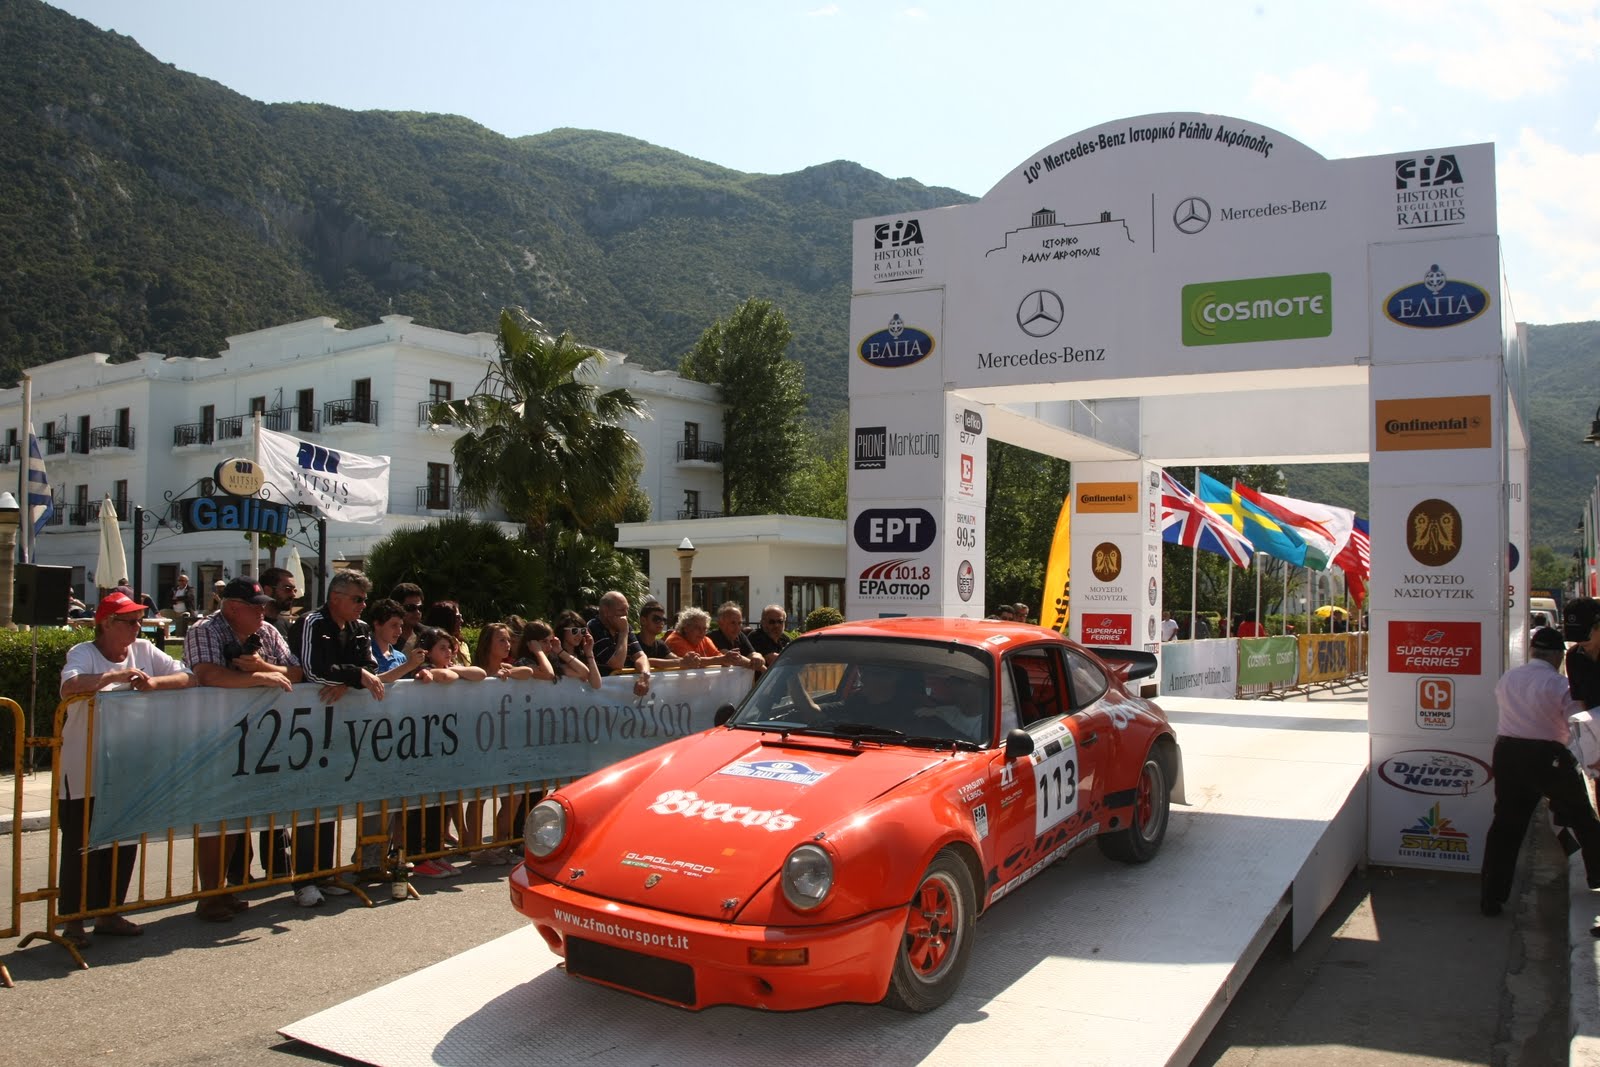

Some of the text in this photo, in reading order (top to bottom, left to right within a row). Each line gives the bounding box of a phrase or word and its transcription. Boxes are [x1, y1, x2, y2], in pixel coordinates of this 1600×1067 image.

[1043, 133, 1126, 172] Mercedes-Benz
[1129, 121, 1175, 143] Ιστορικό
[1178, 121, 1213, 140] Ράλλυ
[1214, 125, 1274, 158] Ακρόπολις
[1397, 187, 1465, 204] HISTORIC
[1220, 199, 1328, 222] Mercedes-Benz
[1396, 199, 1465, 212] REGULARITY
[1397, 207, 1465, 226] RALLIES
[1042, 236, 1079, 249] ΙΣΤΟΡΙΚΟ
[874, 246, 925, 262] HISTORIC
[1052, 246, 1101, 260] ΑΚΡΟΠΟΛΙΣ
[874, 258, 924, 271] RALLY
[873, 268, 925, 280] CHAMPIONSHIP
[1203, 295, 1324, 323] COSMOTE
[1398, 294, 1475, 319] ΕΛΠΑ
[868, 339, 924, 360] ΕΛΠΑ
[977, 346, 1106, 370] Mercedes-Benz
[964, 412, 981, 431] lefko
[1385, 416, 1468, 435] Continental
[857, 431, 940, 459] PHONE Marketing
[229, 475, 259, 486] MITSIS
[290, 470, 349, 496] MITSIS
[1081, 494, 1126, 504] Continental
[192, 498, 289, 535] Galini
[894, 566, 931, 580] 101.8
[1404, 574, 1465, 586] ΜΟΥΣΕΙΟ
[1090, 586, 1123, 594] ΜΟΥΣΕΙΟ
[1394, 588, 1475, 600] ΝΑΣΙΟΥΤΖΙΚ
[1086, 627, 1127, 635] SUPERFAST
[1396, 645, 1473, 657] SUPERFAST
[1405, 656, 1460, 668] FERRIES
[1168, 671, 1203, 692] Anniversary
[1204, 667, 1221, 686] edition
[1419, 710, 1451, 718] OLYMPUS
[232, 692, 692, 782] 125! years of innovation
[1393, 762, 1475, 777] Drivers
[1403, 773, 1462, 788] News
[1039, 759, 1076, 819] 113
[1400, 835, 1469, 853] STAR
[625, 852, 714, 874] GUAGLIARDO
[683, 870, 703, 878] TEAM
[553, 908, 689, 949] www.zfmotorsport.it
